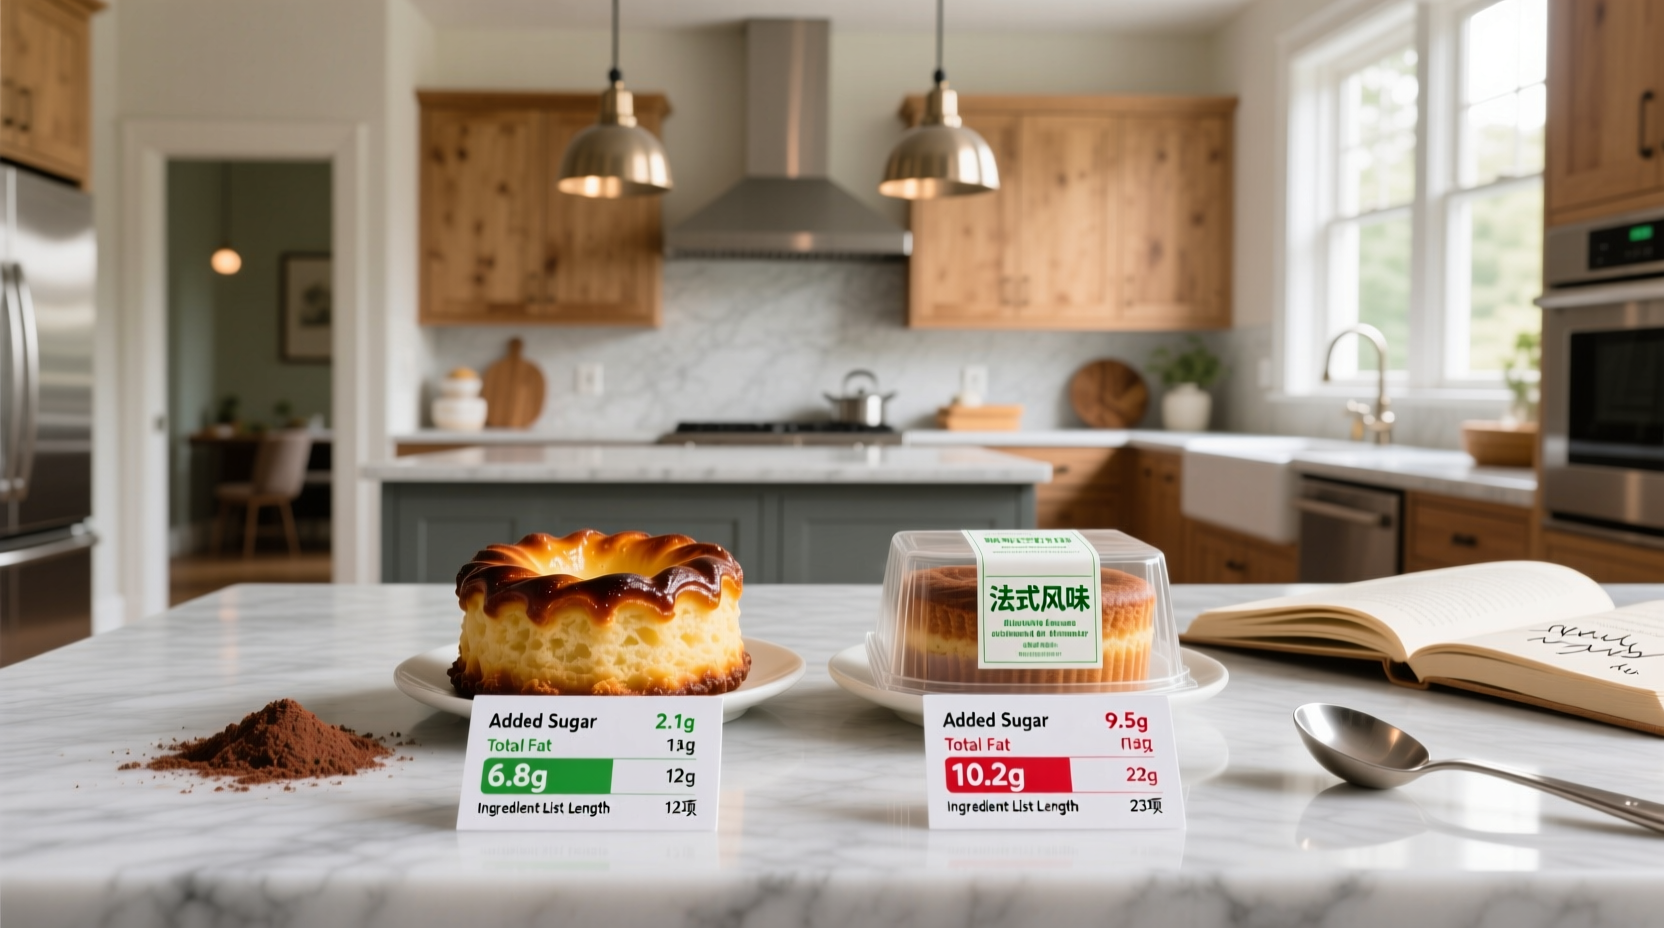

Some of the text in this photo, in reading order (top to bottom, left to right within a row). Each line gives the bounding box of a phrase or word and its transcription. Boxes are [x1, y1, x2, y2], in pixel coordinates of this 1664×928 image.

[990, 585, 1090, 612] 法式风味
[489, 713, 695, 732] Added Sugar 2.1g
[943, 712, 1148, 732] Added Sugar 9.5g
[487, 739, 524, 752] Total
[528, 739, 551, 752] Fat
[945, 738, 1010, 751] Total Fat
[488, 763, 695, 792] 6.8g 12g
[952, 762, 1157, 792] 10.2g 22g
[478, 802, 540, 816] Ingredient
[543, 802, 564, 813] List
[569, 801, 610, 816] Length
[948, 800, 1008, 815] Ingredient
[1013, 800, 1033, 812] List
[1037, 800, 1079, 815] Length
